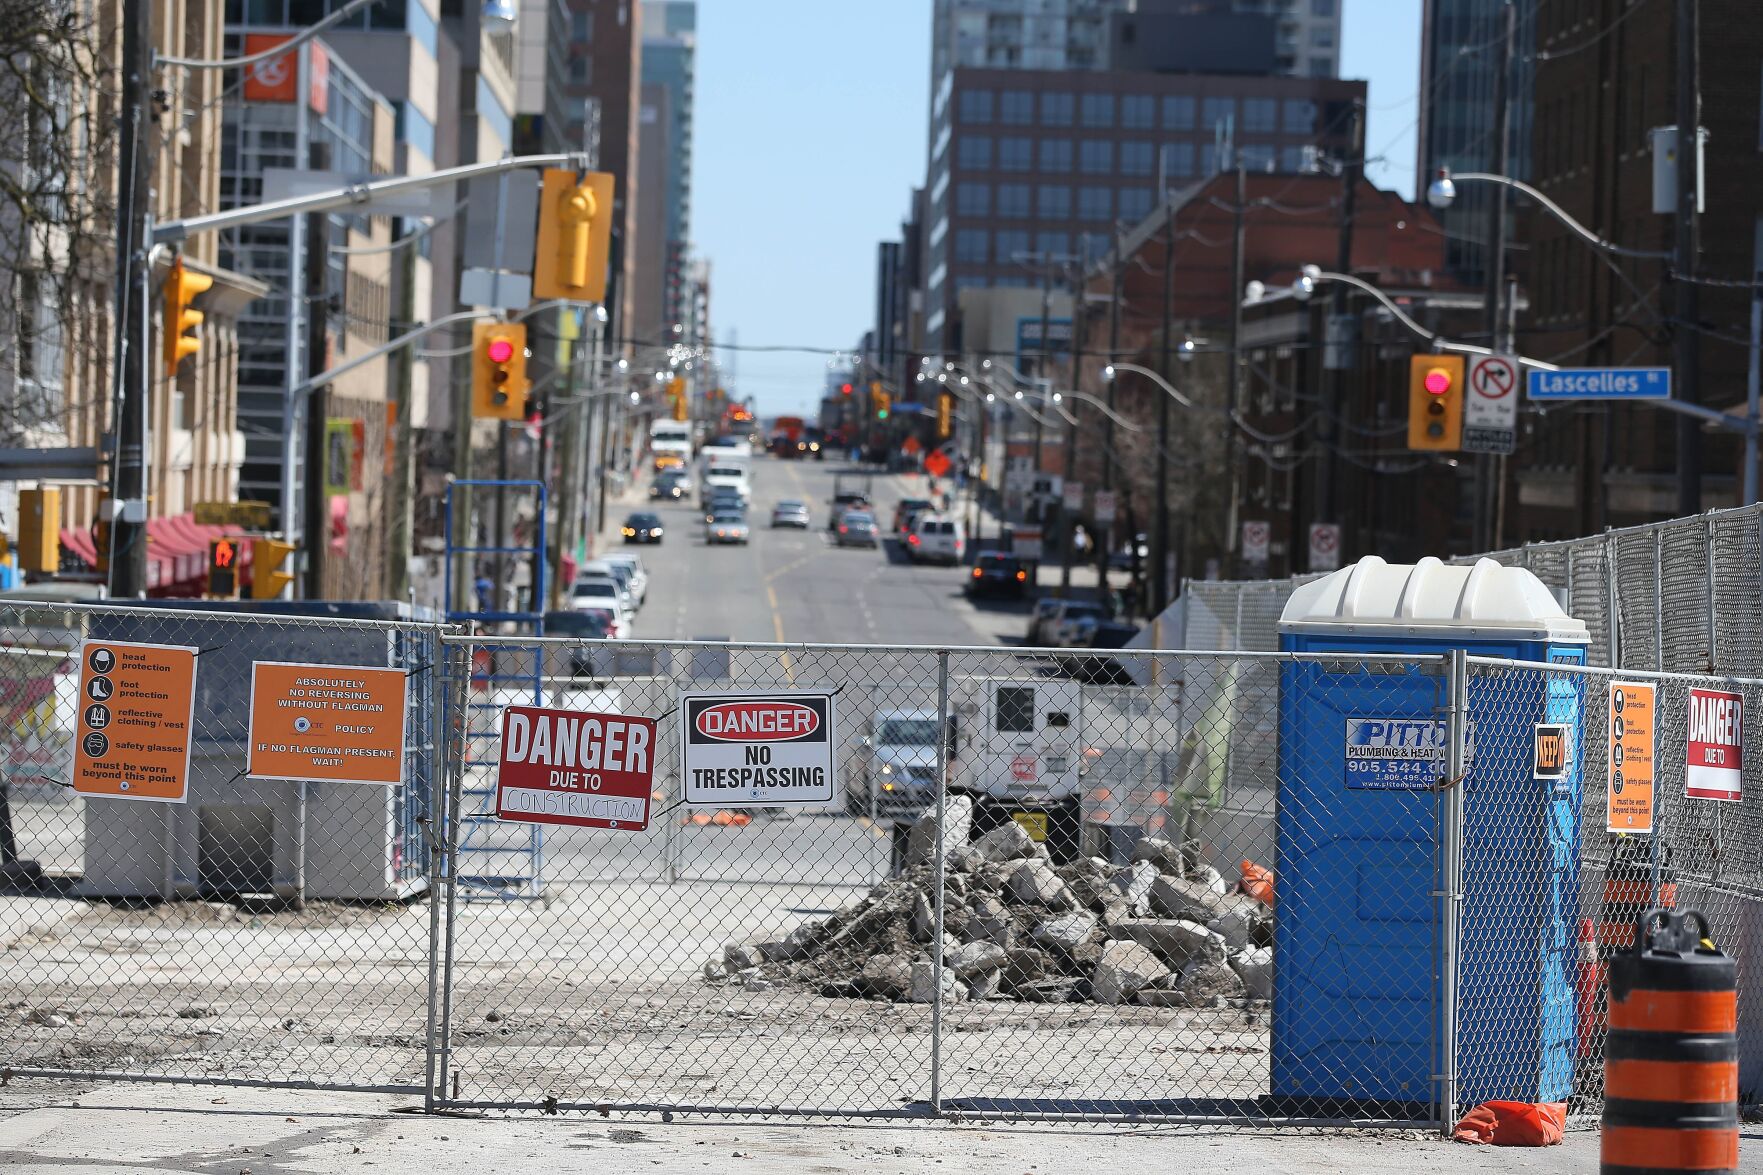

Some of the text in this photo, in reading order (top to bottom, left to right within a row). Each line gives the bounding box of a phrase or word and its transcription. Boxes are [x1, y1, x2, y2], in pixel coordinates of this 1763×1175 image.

[1539, 373, 1640, 392] Lascelles
[122, 653, 146, 662] head
[122, 662, 171, 672] protection
[120, 680, 140, 689] foot
[295, 677, 366, 688] ABSOLUTELY
[120, 690, 169, 700] protection
[289, 688, 370, 700] NO REVERSING
[1626, 692, 1636, 700] head
[278, 700, 384, 712] WITHOUT FLAGMAN
[118, 709, 163, 718] reflective
[118, 718, 156, 729] clothing
[164, 721, 184, 729] vest
[705, 710, 811, 733] DANGER
[1689, 695, 1742, 747] DANGER
[335, 724, 375, 734] POLICY
[116, 741, 184, 753] safety glasses
[506, 713, 650, 774] DANGER
[258, 744, 396, 758] IF NO FLAGMAN PRESENT,
[745, 745, 772, 766] NO
[1348, 747, 1399, 757] PLUMBING
[1401, 749, 1409, 757] &
[1537, 735, 1558, 768] KEEP
[1626, 746, 1644, 754] reflective
[1626, 755, 1642, 763] clothing
[1704, 747, 1725, 765] DUE TO
[92, 762, 168, 774] must be worn
[312, 758, 344, 767] WAIT!
[82, 768, 176, 783] beyond this point
[550, 771, 602, 790] DUE TO
[692, 766, 825, 789] TRESPASSING
[1626, 778, 1652, 786] safety glasses
[507, 789, 644, 820] CONSTRUCTION
[1616, 798, 1628, 806] must
[1630, 798, 1634, 806] be
[1612, 806, 1629, 815] beyond
[1638, 806, 1650, 815] point
